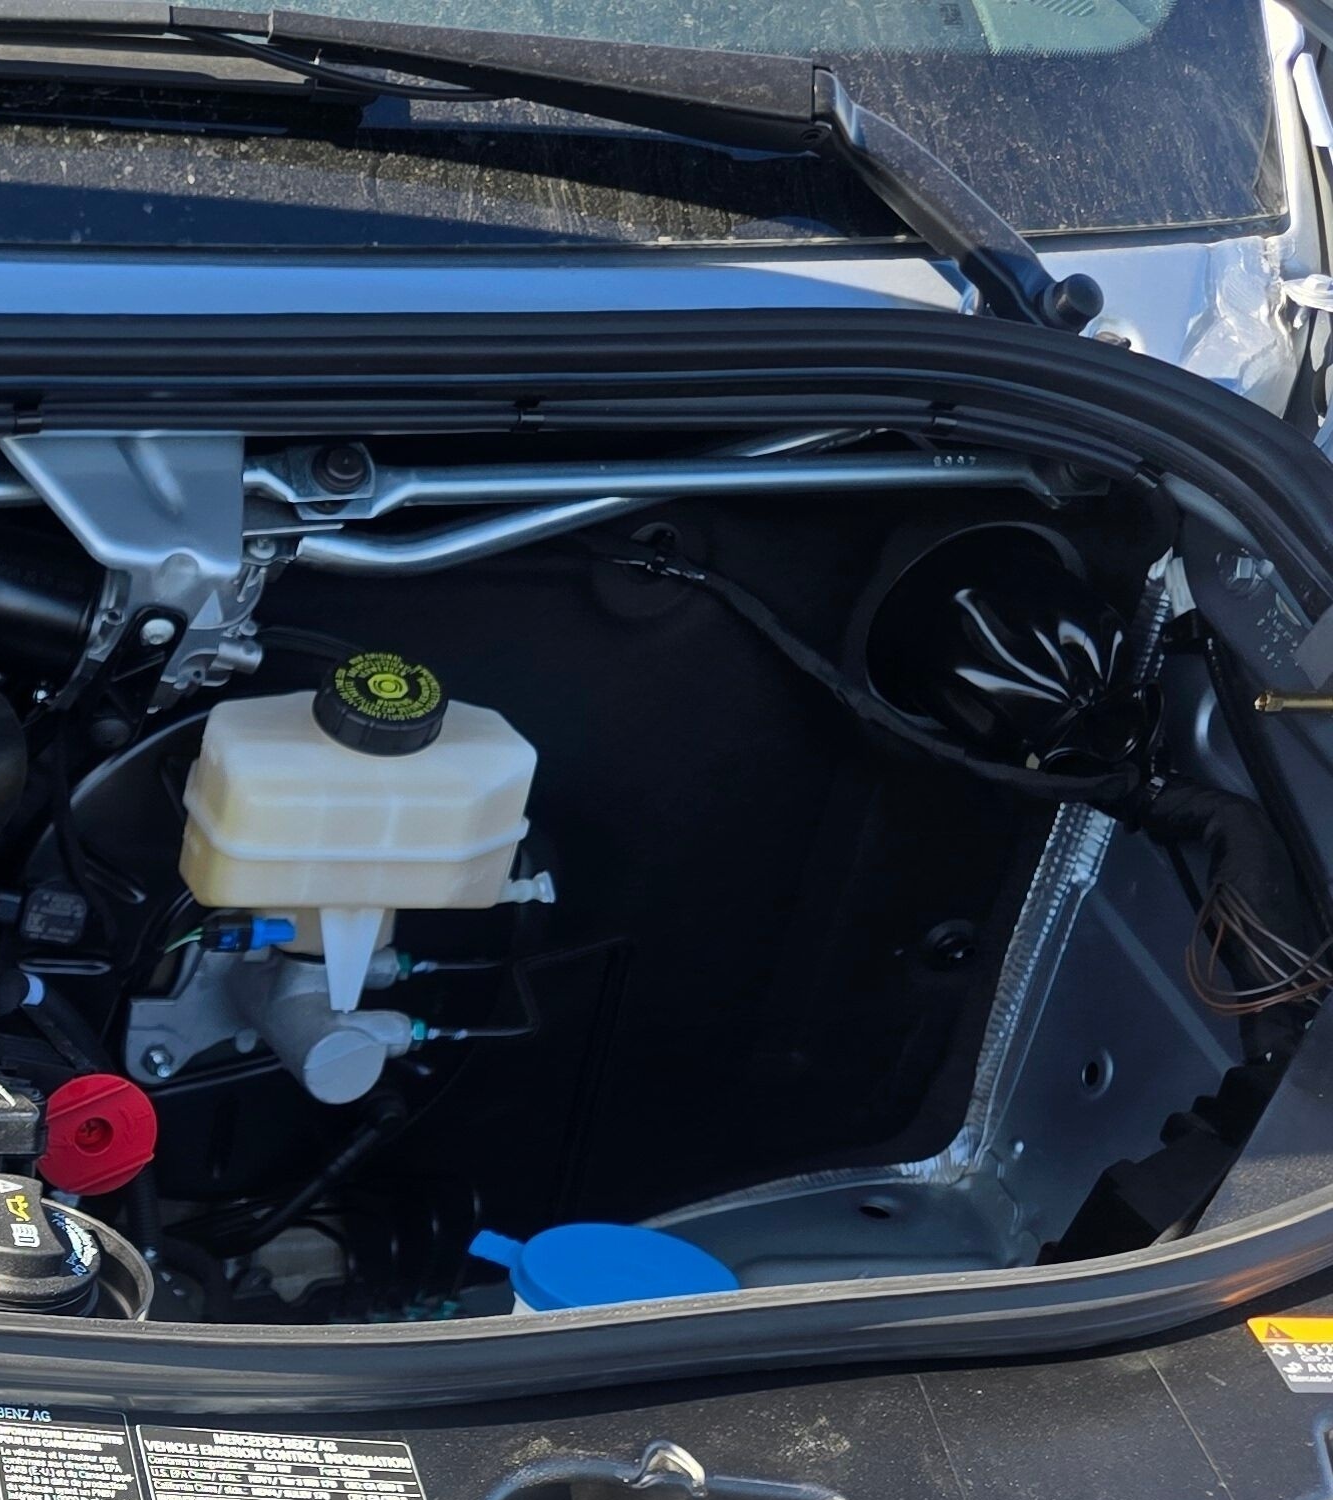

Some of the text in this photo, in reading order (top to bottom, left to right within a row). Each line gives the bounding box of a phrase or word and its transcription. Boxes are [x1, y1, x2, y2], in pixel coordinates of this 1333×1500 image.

[1293, 1343, 1333, 1356] R-12
[33, 1410, 51, 1422] AG
[25, 1436, 41, 1446] LES
[213, 1433, 337, 1452] MERCEDES-BENZ AG
[144, 1440, 412, 1468] VEHICLE EMISSION CONTROL INFORMATION
[3, 1465, 27, 1474] CARB
[79, 1471, 110, 1480] Canada
[105, 1464, 123, 1473] EPA
[83, 1480, 127, 1490] production
